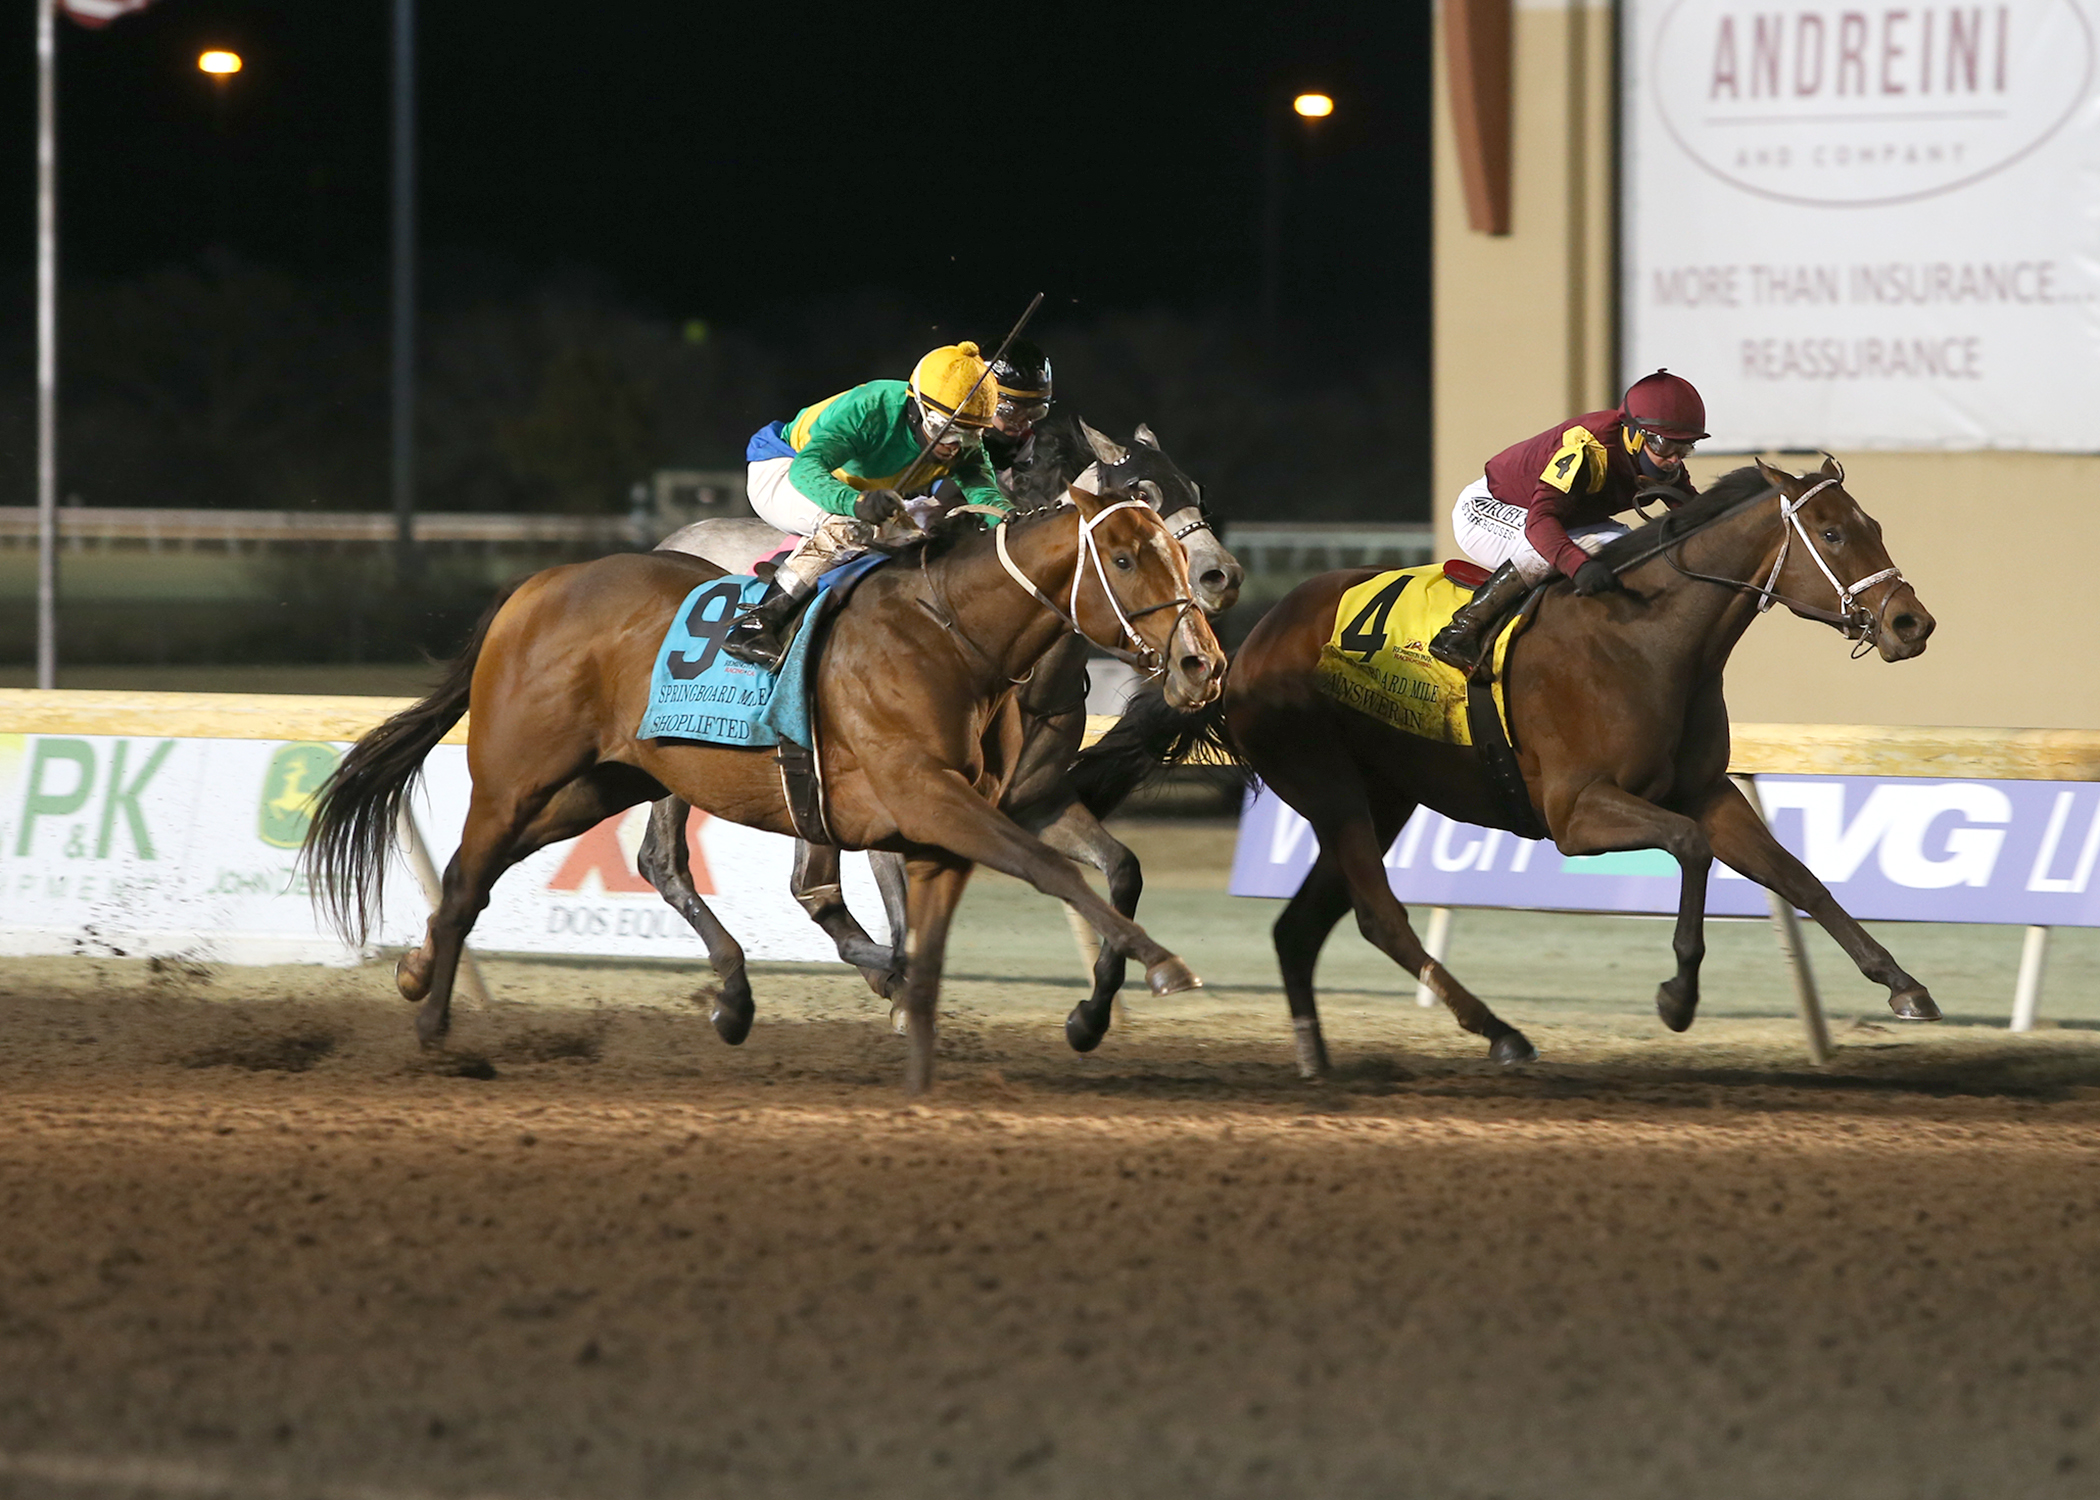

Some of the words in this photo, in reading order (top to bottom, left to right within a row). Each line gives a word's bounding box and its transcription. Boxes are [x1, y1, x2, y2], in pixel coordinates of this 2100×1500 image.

[1709, 7, 2009, 101] ANDREINI
[1736, 146, 1793, 169] AND
[1814, 143, 1968, 167] COMPANY
[1653, 265, 1741, 307] MORE
[1748, 264, 1840, 304] THAN
[1740, 336, 1984, 380] REASSURANCE
[1554, 452, 1578, 480] 4
[666, 582, 742, 680] 9
[1340, 574, 1416, 664] 4
[658, 684, 738, 705] SPRINGBOARD
[1323, 672, 1400, 722] ANSWER
[1402, 707, 1423, 731] IN
[1410, 680, 1439, 703] MILE
[650, 714, 750, 740] SHOPLIFTED
[1714, 780, 2013, 889] TVG
[546, 905, 610, 936] DOS
